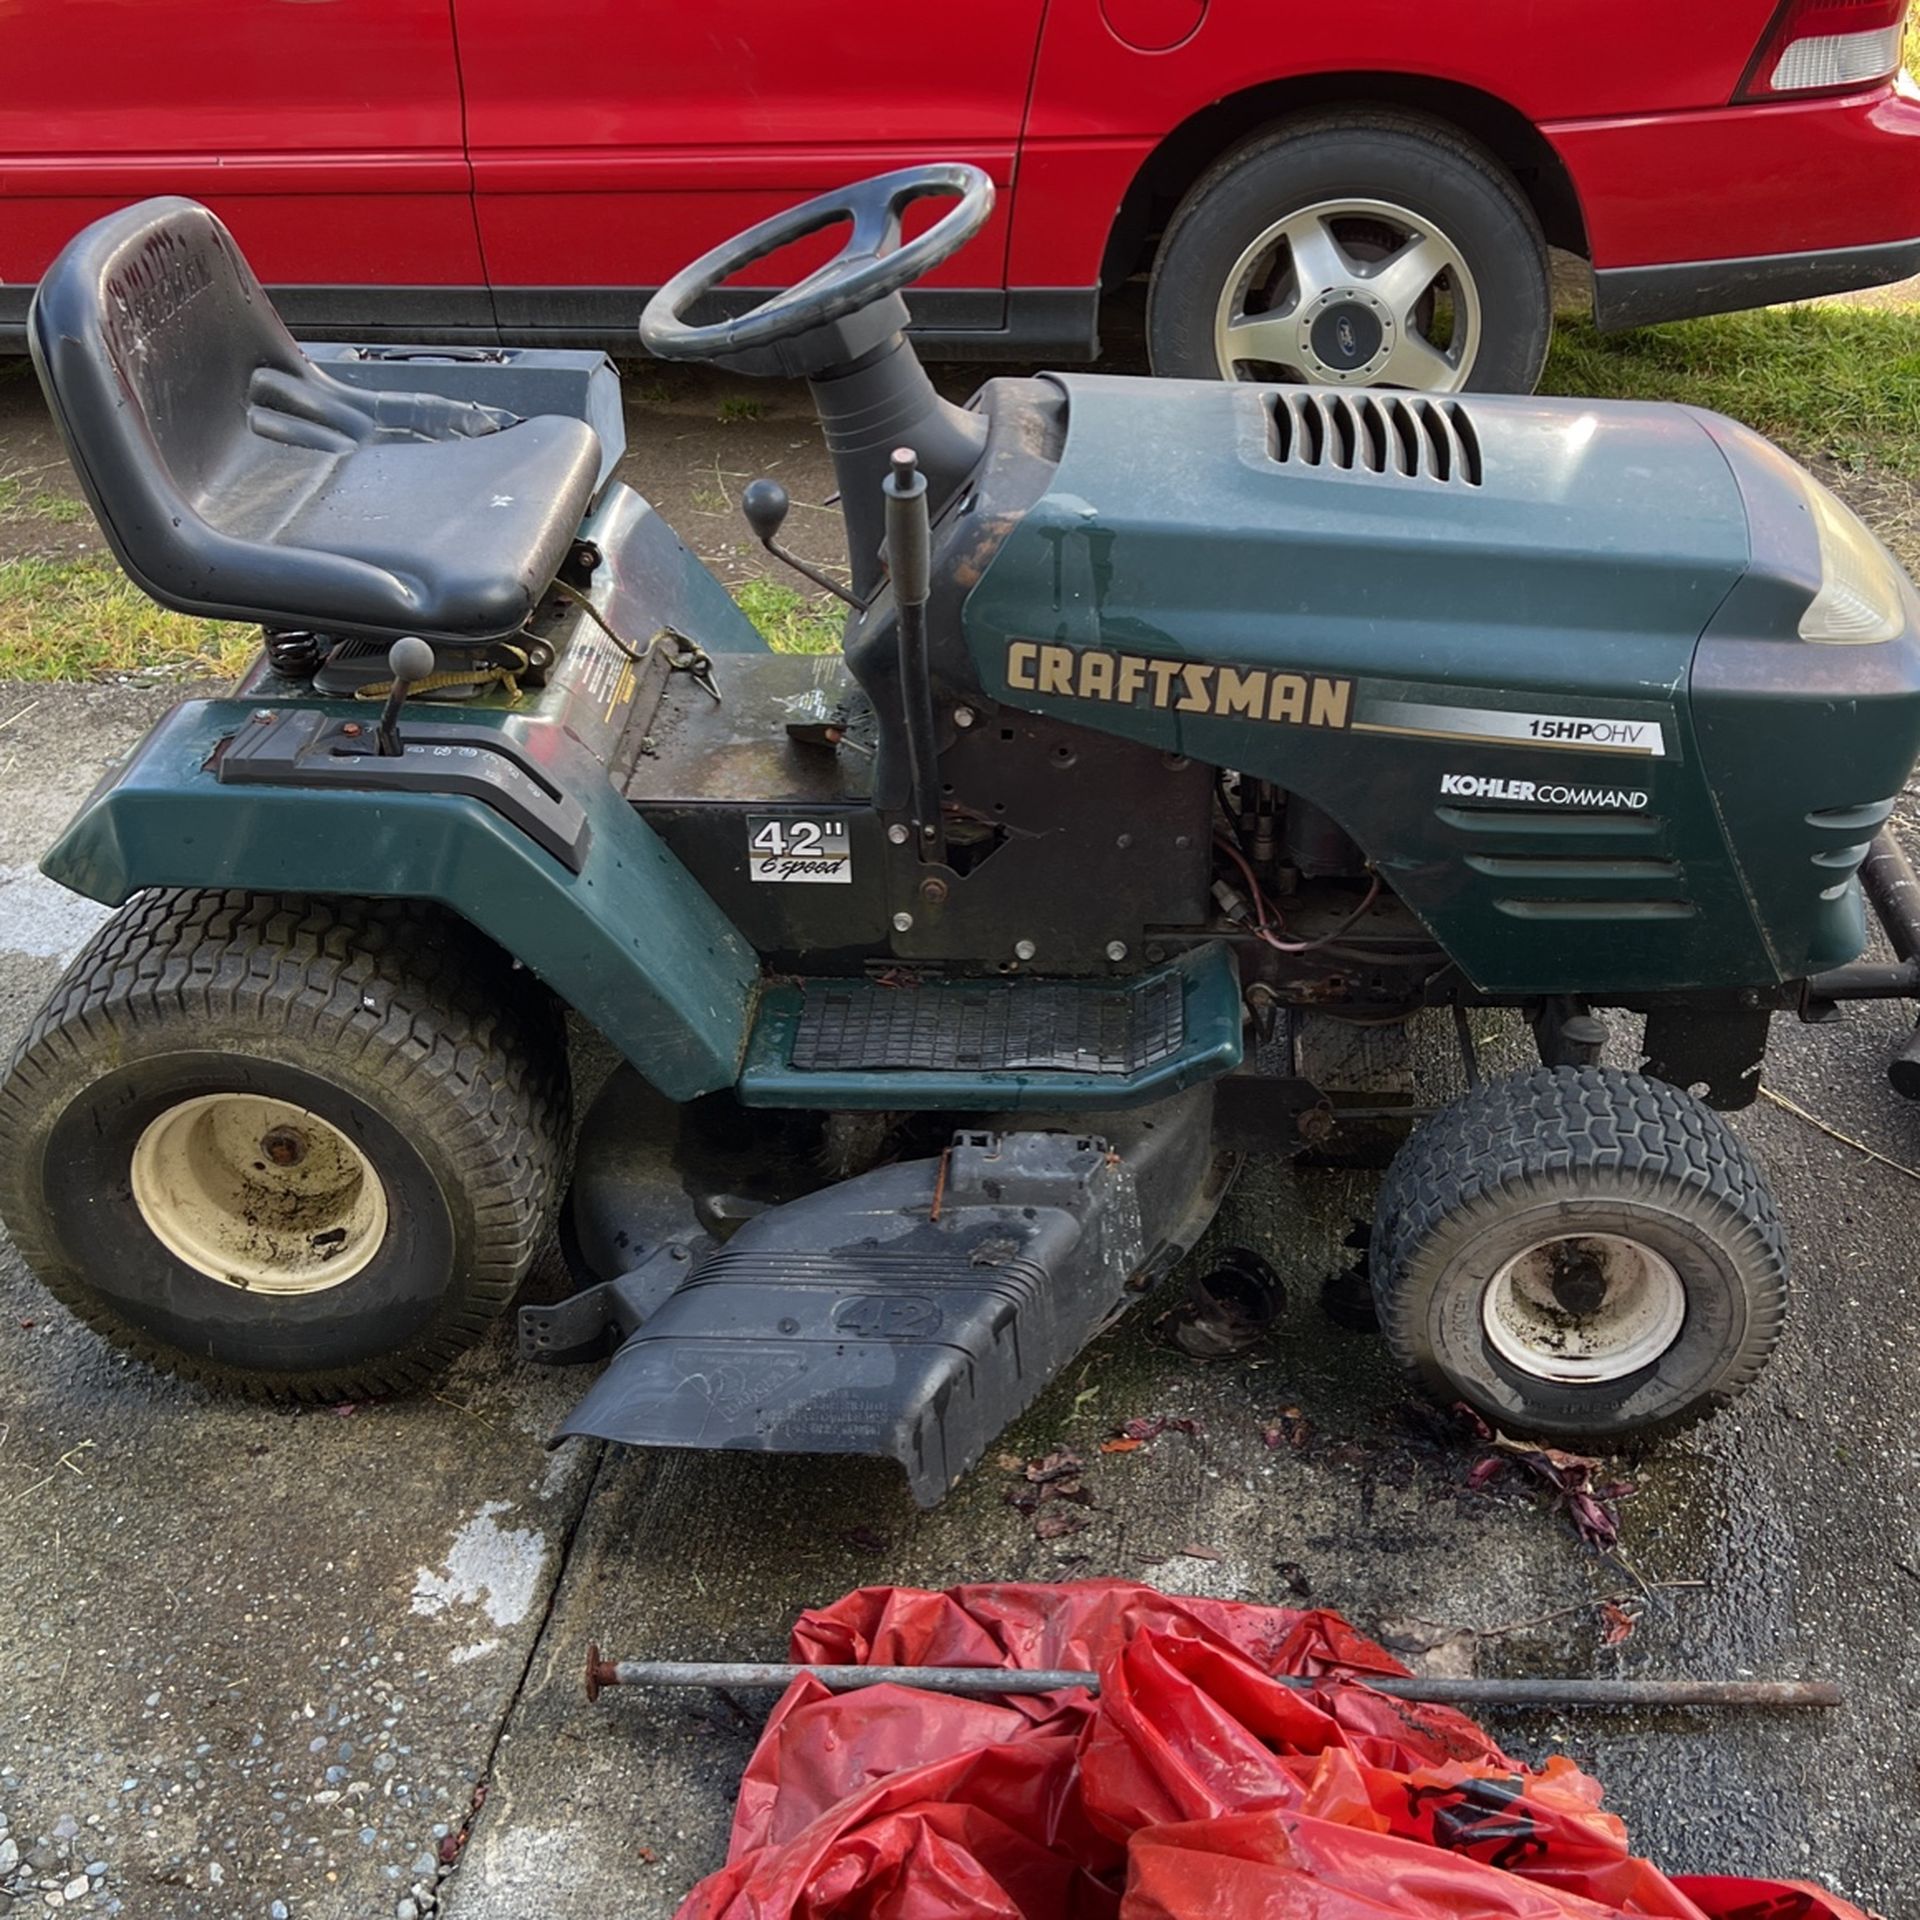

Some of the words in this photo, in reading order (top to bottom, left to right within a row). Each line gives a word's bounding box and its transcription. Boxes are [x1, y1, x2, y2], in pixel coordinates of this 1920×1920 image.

[1007, 641, 1351, 729] CRAFTSMAN
[1440, 774, 1536, 801] KOHLER
[1537, 785, 1648, 808] COMMAND
[753, 821, 843, 857] 42"
[760, 858, 778, 874] 6
[778, 856, 848, 880] speed
[836, 1299, 938, 1338] 42
